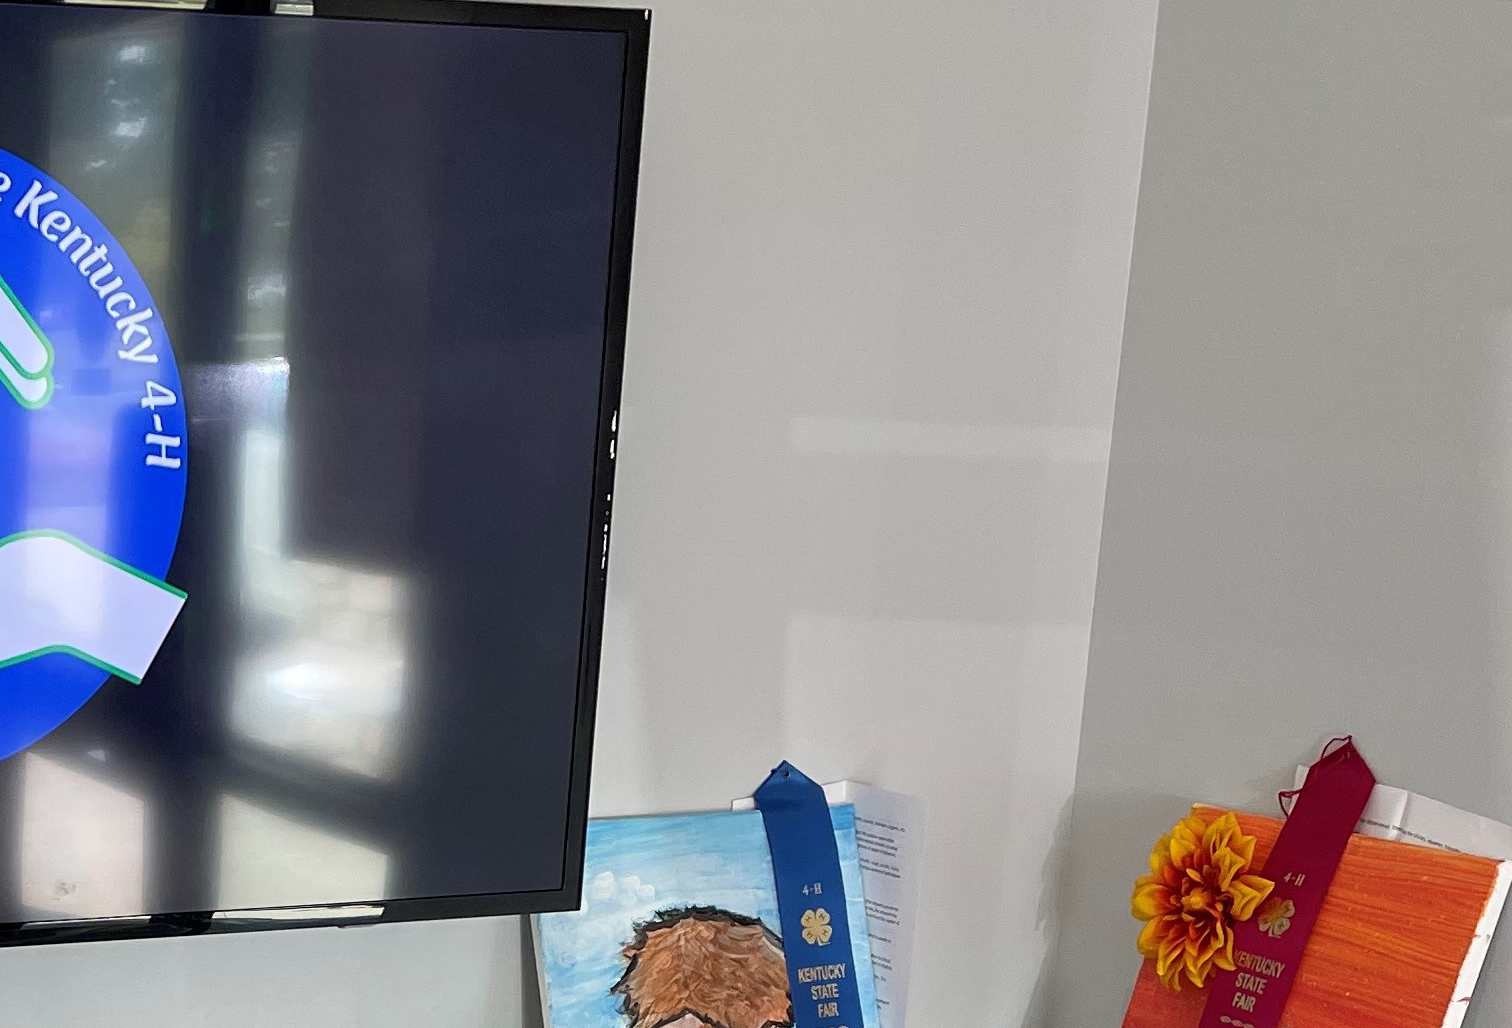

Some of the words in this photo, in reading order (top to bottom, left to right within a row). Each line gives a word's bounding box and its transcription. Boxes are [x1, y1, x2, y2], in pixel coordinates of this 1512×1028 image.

[13, 179, 159, 364] Kentucky
[141, 380, 181, 469] 4-H
[802, 883, 823, 895] 4-H
[1283, 871, 1306, 887] 4-H
[797, 963, 846, 984] KENTUCKY
[1234, 950, 1286, 979] KENTUCKY
[810, 983, 839, 1000] STATE
[1235, 972, 1268, 995] STATE
[817, 1002, 839, 1018] FAIR
[1231, 992, 1256, 1013] FAIR
